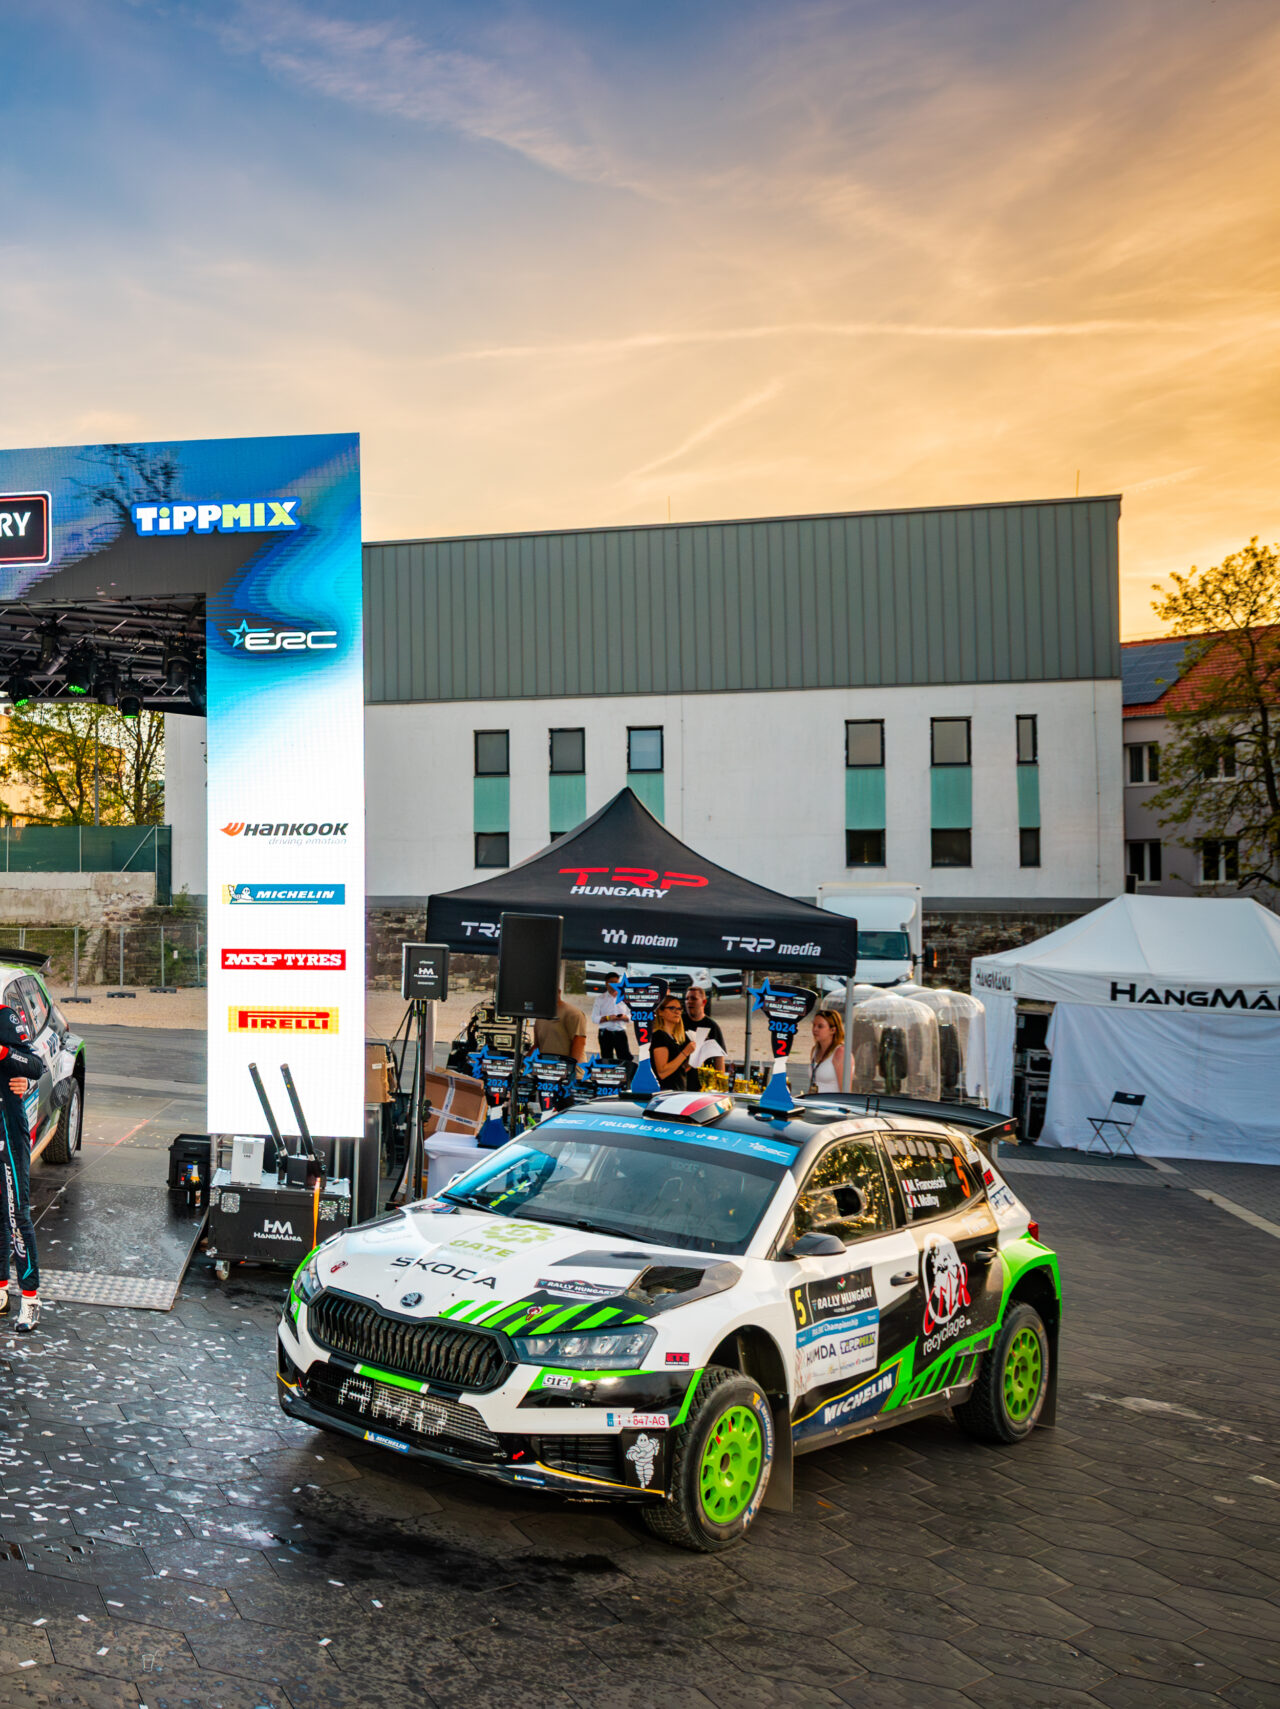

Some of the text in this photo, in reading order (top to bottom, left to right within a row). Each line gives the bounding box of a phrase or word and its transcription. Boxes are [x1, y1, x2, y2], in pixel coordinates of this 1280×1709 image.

[244, 630, 337, 651] ERC
[558, 867, 709, 889] TRP
[256, 890, 335, 899] MICHELIN
[570, 886, 669, 898] HUNGARY
[461, 921, 501, 938] TR
[631, 933, 678, 948] motam
[721, 935, 821, 957] TRP media
[224, 953, 342, 966] MRF TYRES
[238, 1010, 330, 1030] PIRELLI
[631, 1011, 654, 1021] 2024
[770, 1020, 796, 1034] 2024
[639, 1028, 648, 1043] 2
[776, 1040, 787, 1056] 2
[487, 1078, 508, 1087] 2024
[537, 1082, 559, 1091] 2024
[493, 1093, 500, 1105] 1
[596, 1087, 618, 1096] 2024
[543, 1097, 550, 1109] 1
[599, 1120, 638, 1129] FOLLOW
[953, 1155, 971, 1199] 5
[263, 1219, 293, 1235] HM
[547, 1281, 616, 1297] RALLY HUNGARY
[817, 1294, 841, 1310] RALLY
[840, 1286, 873, 1305] HUNGARY
[794, 1289, 807, 1326] 5
[824, 1373, 893, 1425] MICHELIN
[375, 1435, 408, 1450] MICHELIN
